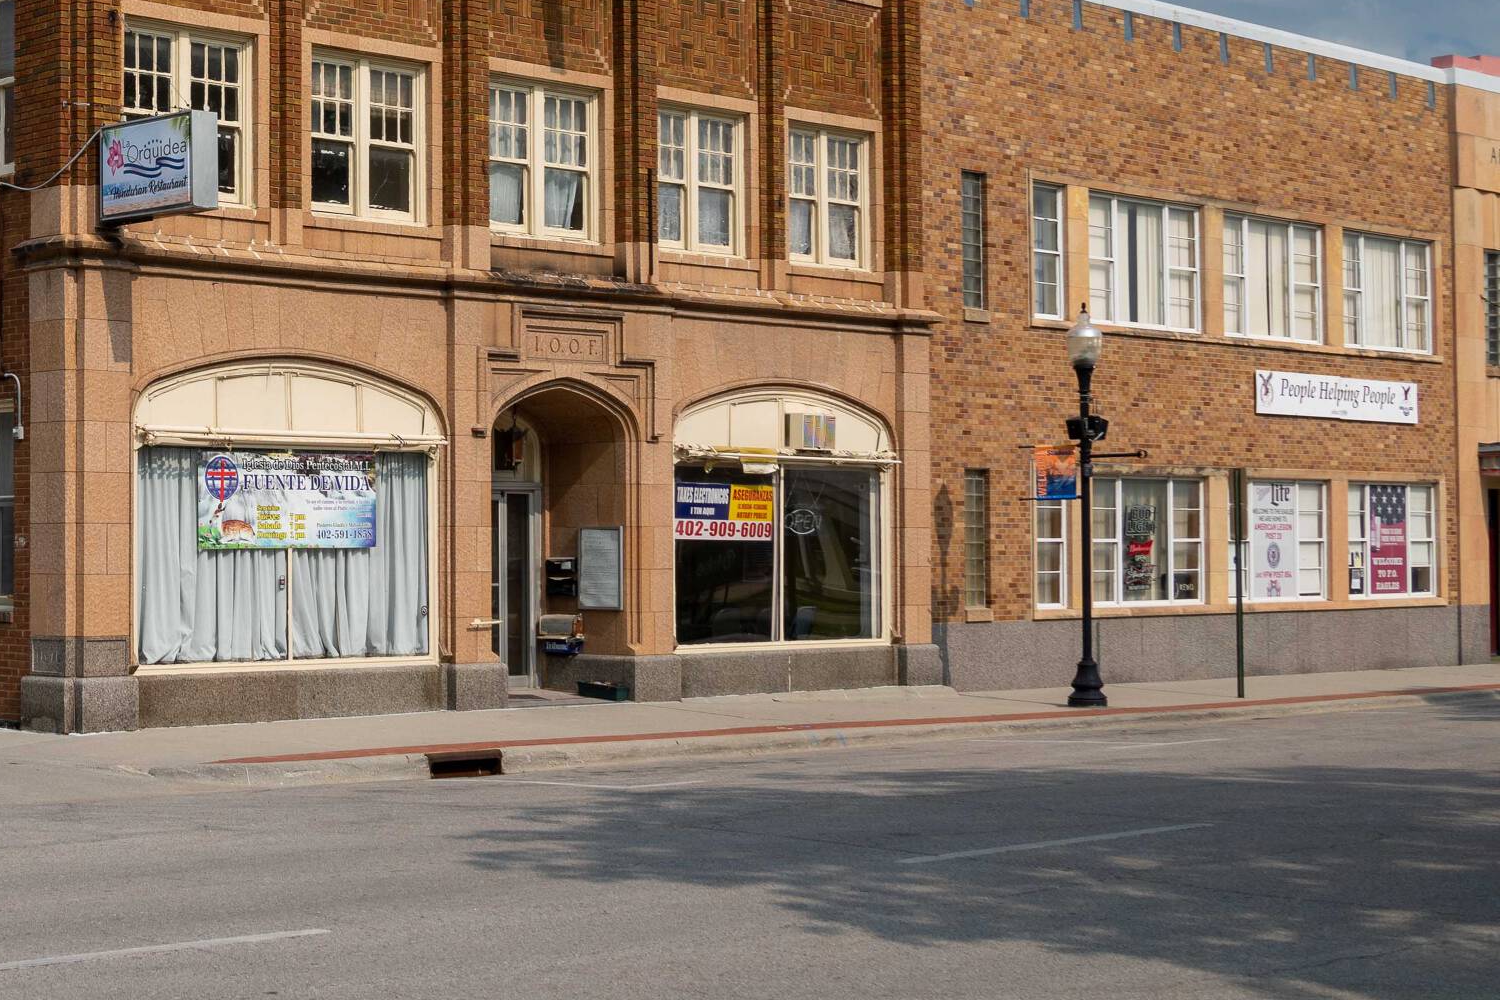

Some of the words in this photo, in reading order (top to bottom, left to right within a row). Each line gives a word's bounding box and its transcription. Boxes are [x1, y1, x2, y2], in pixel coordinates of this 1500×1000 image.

[123, 140, 131, 149] La
[110, 185, 148, 200] Honduran
[148, 175, 188, 194] Restaurant
[1280, 378, 1316, 404] People
[1319, 381, 1360, 409] Helping
[1362, 385, 1396, 410] People
[242, 458, 272, 472] Iglesia
[273, 459, 284, 470] de
[285, 458, 304, 471] Dios
[306, 459, 353, 472] Pentecostal
[243, 474, 308, 491] FUENTE
[309, 475, 333, 491] DE
[333, 475, 371, 491] VIDA
[677, 486, 693, 503] TAXES
[693, 487, 729, 505] ELECTRONICOS
[733, 489, 772, 502] ASEGURANZAS
[1270, 483, 1290, 506] Lite
[675, 520, 772, 537] 402-909-6009
